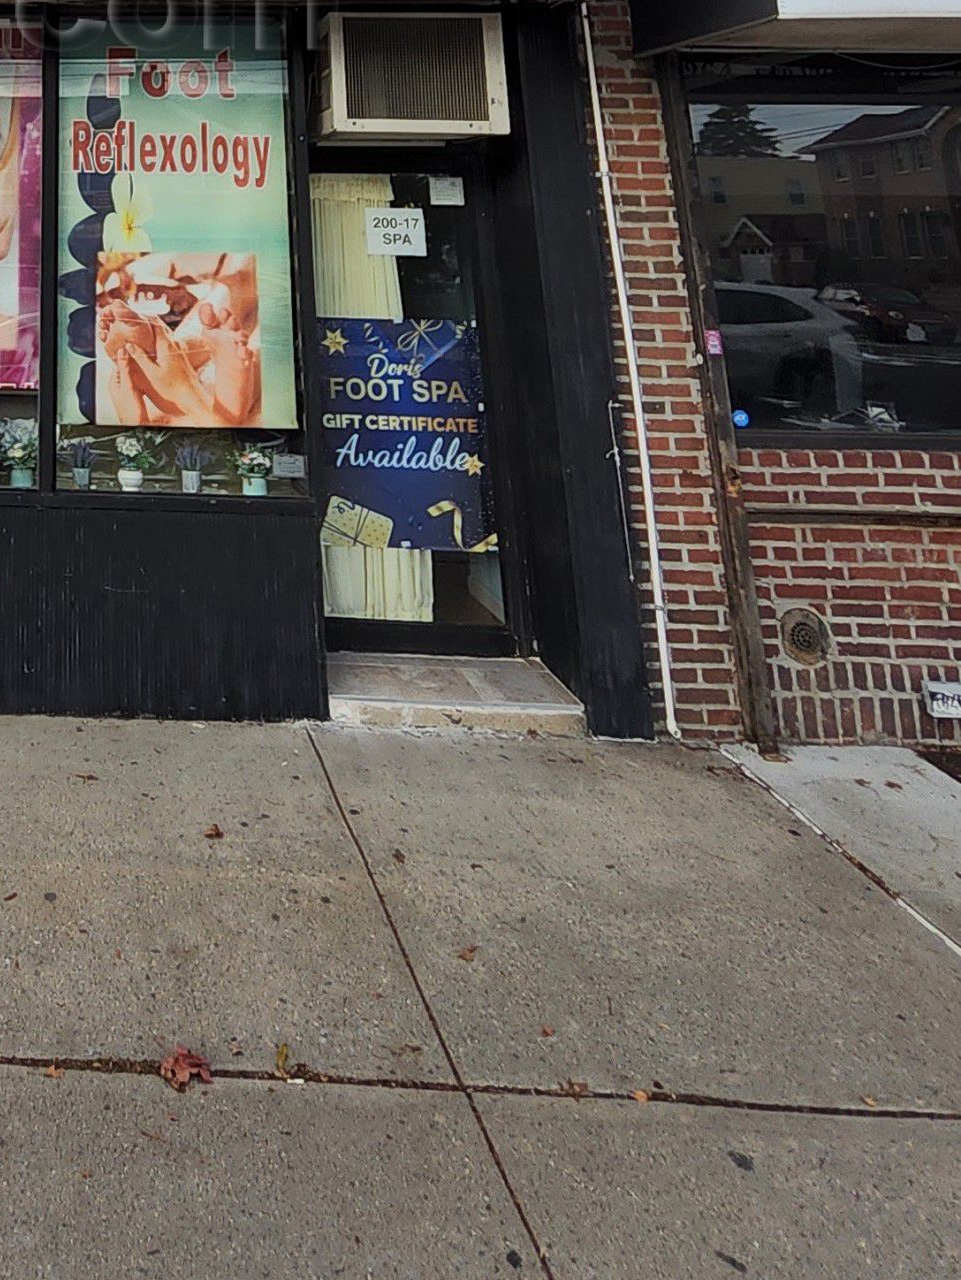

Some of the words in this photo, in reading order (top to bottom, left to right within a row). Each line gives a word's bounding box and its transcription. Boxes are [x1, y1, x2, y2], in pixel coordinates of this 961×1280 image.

[105, 47, 237, 100] Foot
[71, 120, 272, 189] Reflexology
[372, 216, 420, 230] 200-17
[382, 232, 413, 246] SPA
[367, 352, 425, 380] Doris
[329, 377, 405, 402] FOOT
[412, 378, 469, 404] SPA
[322, 414, 363, 430] GIFT
[365, 414, 480, 434] CERTIFICATE
[335, 432, 473, 472] Available
